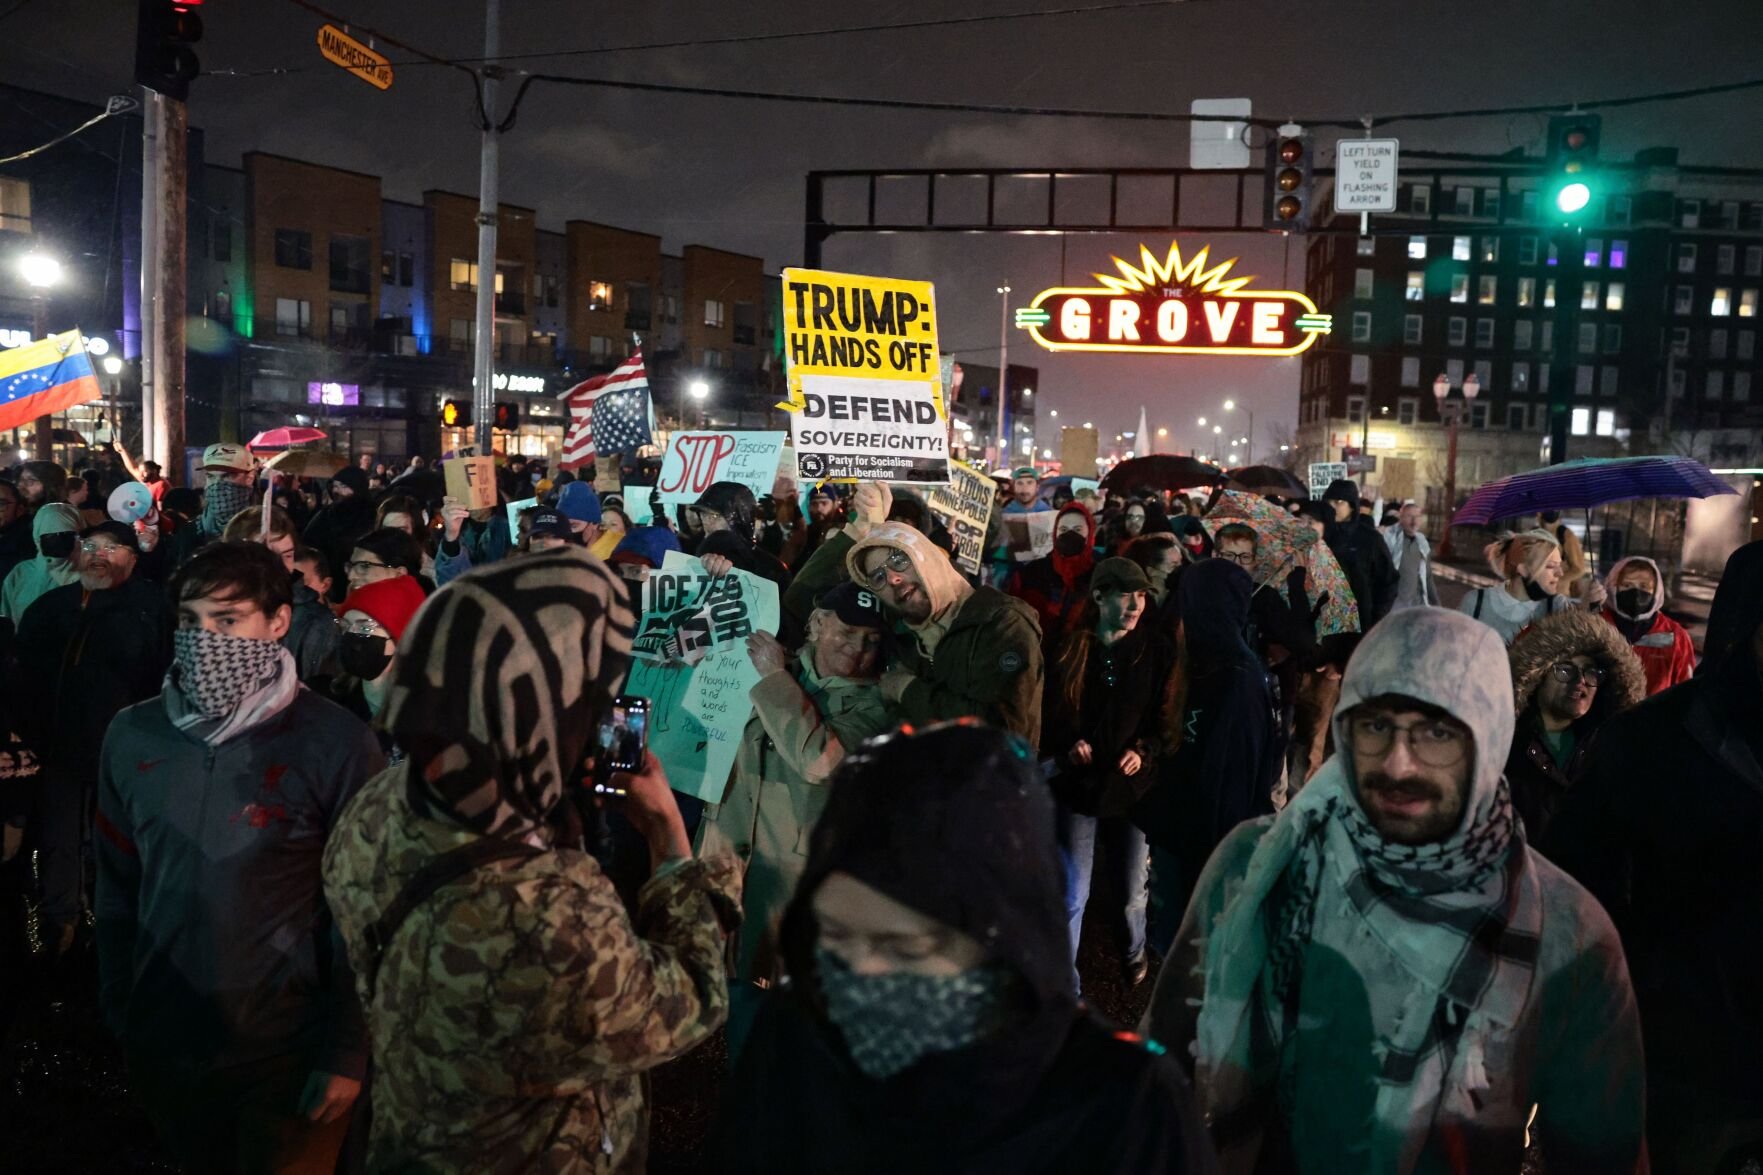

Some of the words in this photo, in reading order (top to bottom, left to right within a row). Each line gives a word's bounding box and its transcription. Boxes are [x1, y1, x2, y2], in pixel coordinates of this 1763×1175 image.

[322, 30, 377, 77] MANCHESTER
[1343, 147, 1364, 157] LEFT
[1367, 147, 1391, 156] TURN
[1354, 160, 1380, 168] YIELD
[1360, 172, 1373, 180] ON
[1343, 183, 1389, 192] FLASHING
[1350, 195, 1381, 203] ARROW
[1163, 288, 1182, 298] THE
[789, 282, 931, 336] TRUMP:
[1060, 297, 1285, 344] GROVE
[791, 333, 882, 369] HANDS
[889, 341, 933, 373] OFF
[803, 393, 937, 425] DEFEND
[800, 430, 943, 451] SOVEREIGNTY!
[661, 434, 736, 493] STOP
[735, 438, 777, 454] Fascism
[730, 454, 748, 467] ICE
[828, 454, 853, 467] Party
[856, 456, 868, 466] for
[870, 457, 914, 467] Socialism
[830, 467, 846, 477] and
[849, 468, 894, 478] Liberation
[958, 476, 990, 506] LOUIS
[933, 489, 988, 524] MINNEAPOLIS
[649, 574, 691, 614] ICE
[717, 654, 742, 672] your
[699, 671, 742, 690] thoughts
[701, 687, 720, 699] and
[701, 699, 728, 713] words
[701, 711, 715, 722] are
